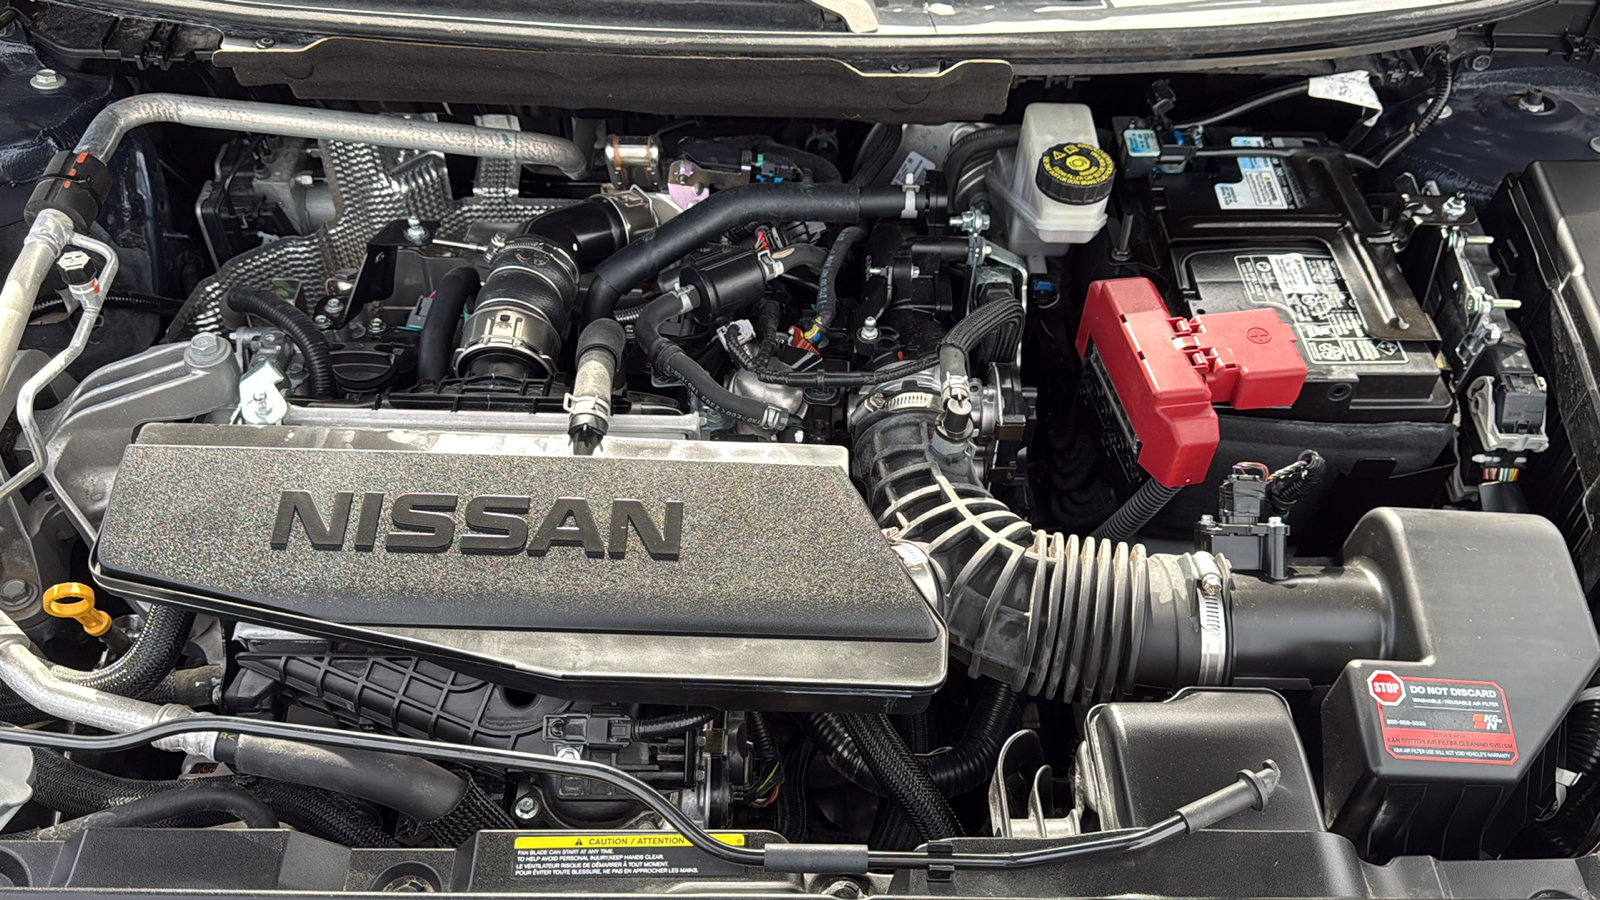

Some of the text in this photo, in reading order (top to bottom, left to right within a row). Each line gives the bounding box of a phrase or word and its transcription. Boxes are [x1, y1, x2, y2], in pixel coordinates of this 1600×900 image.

[270, 490, 684, 561] NISSAN
[1373, 682, 1400, 694] STOP
[1410, 686, 1497, 698] DO NOT DISCARD
